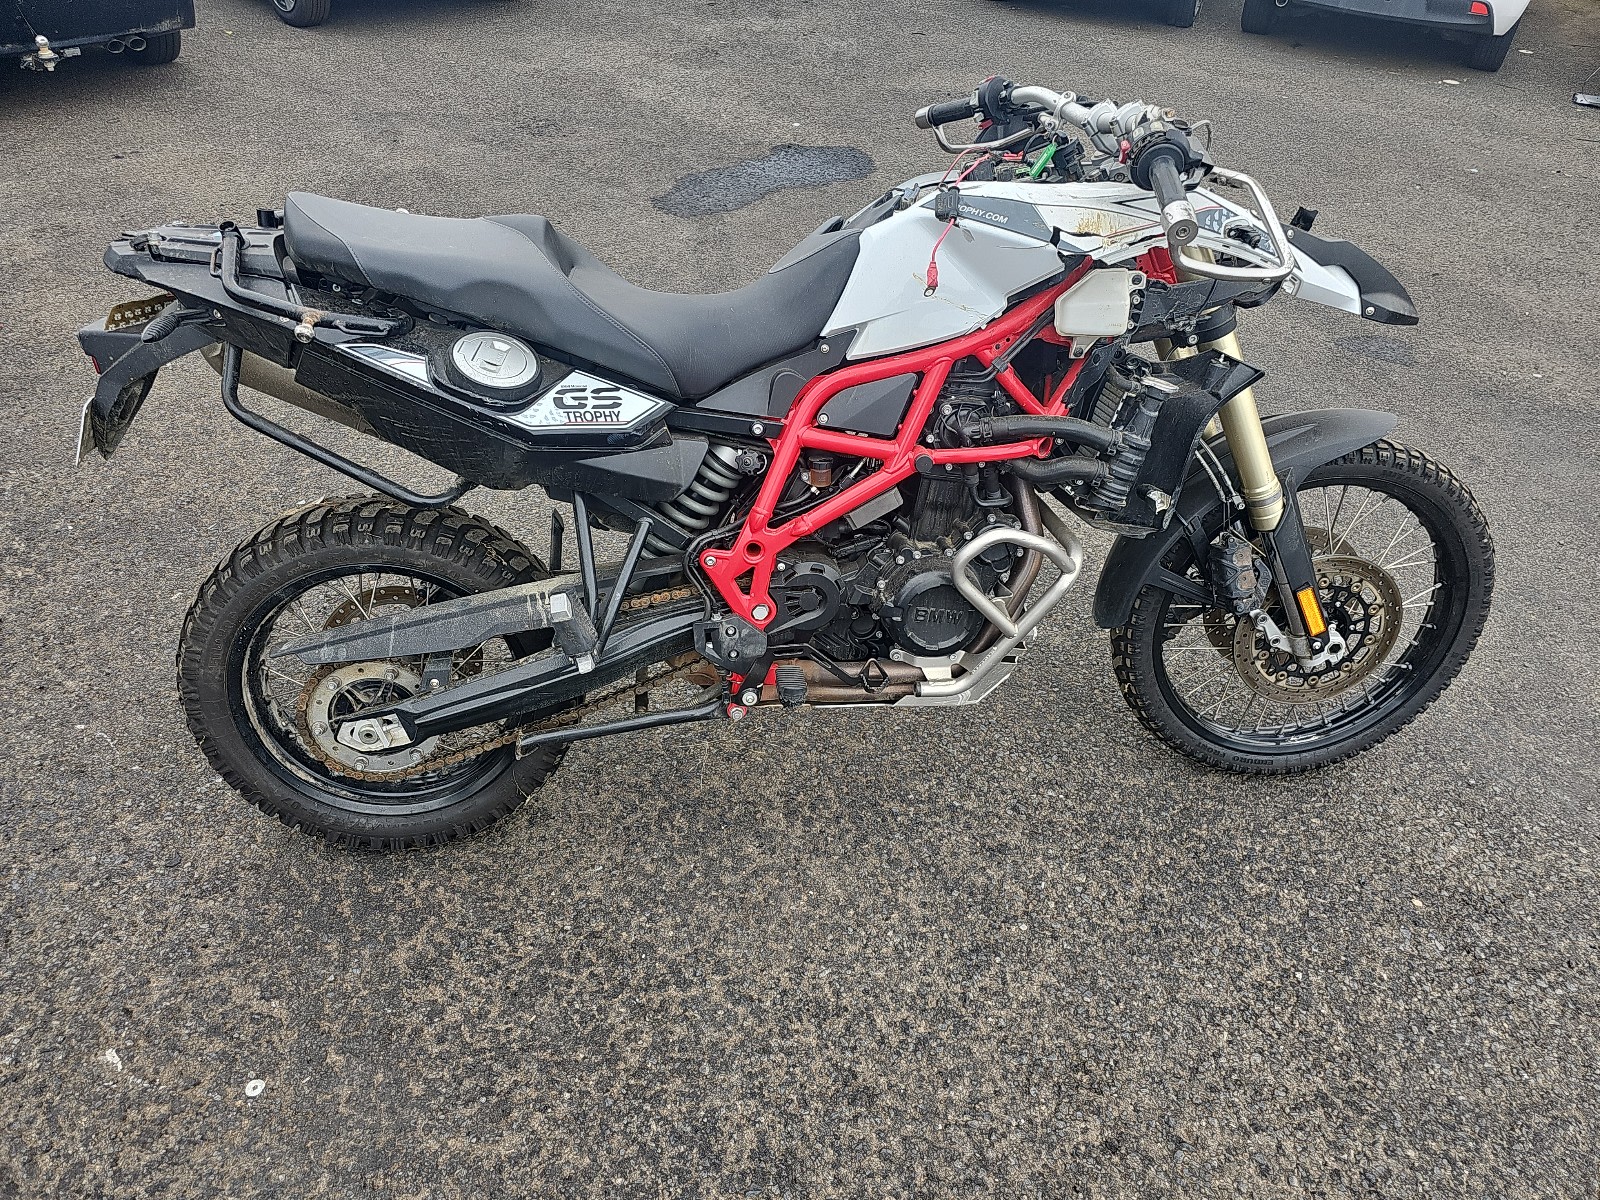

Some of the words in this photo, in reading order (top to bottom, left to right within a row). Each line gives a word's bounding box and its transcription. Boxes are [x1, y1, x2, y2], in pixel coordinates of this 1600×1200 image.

[957, 205, 1009, 224] OPHY.COM
[553, 388, 623, 409] GS
[563, 410, 621, 422] TROPHY
[914, 606, 964, 624] BMW
[1233, 755, 1274, 766] ENDURO
